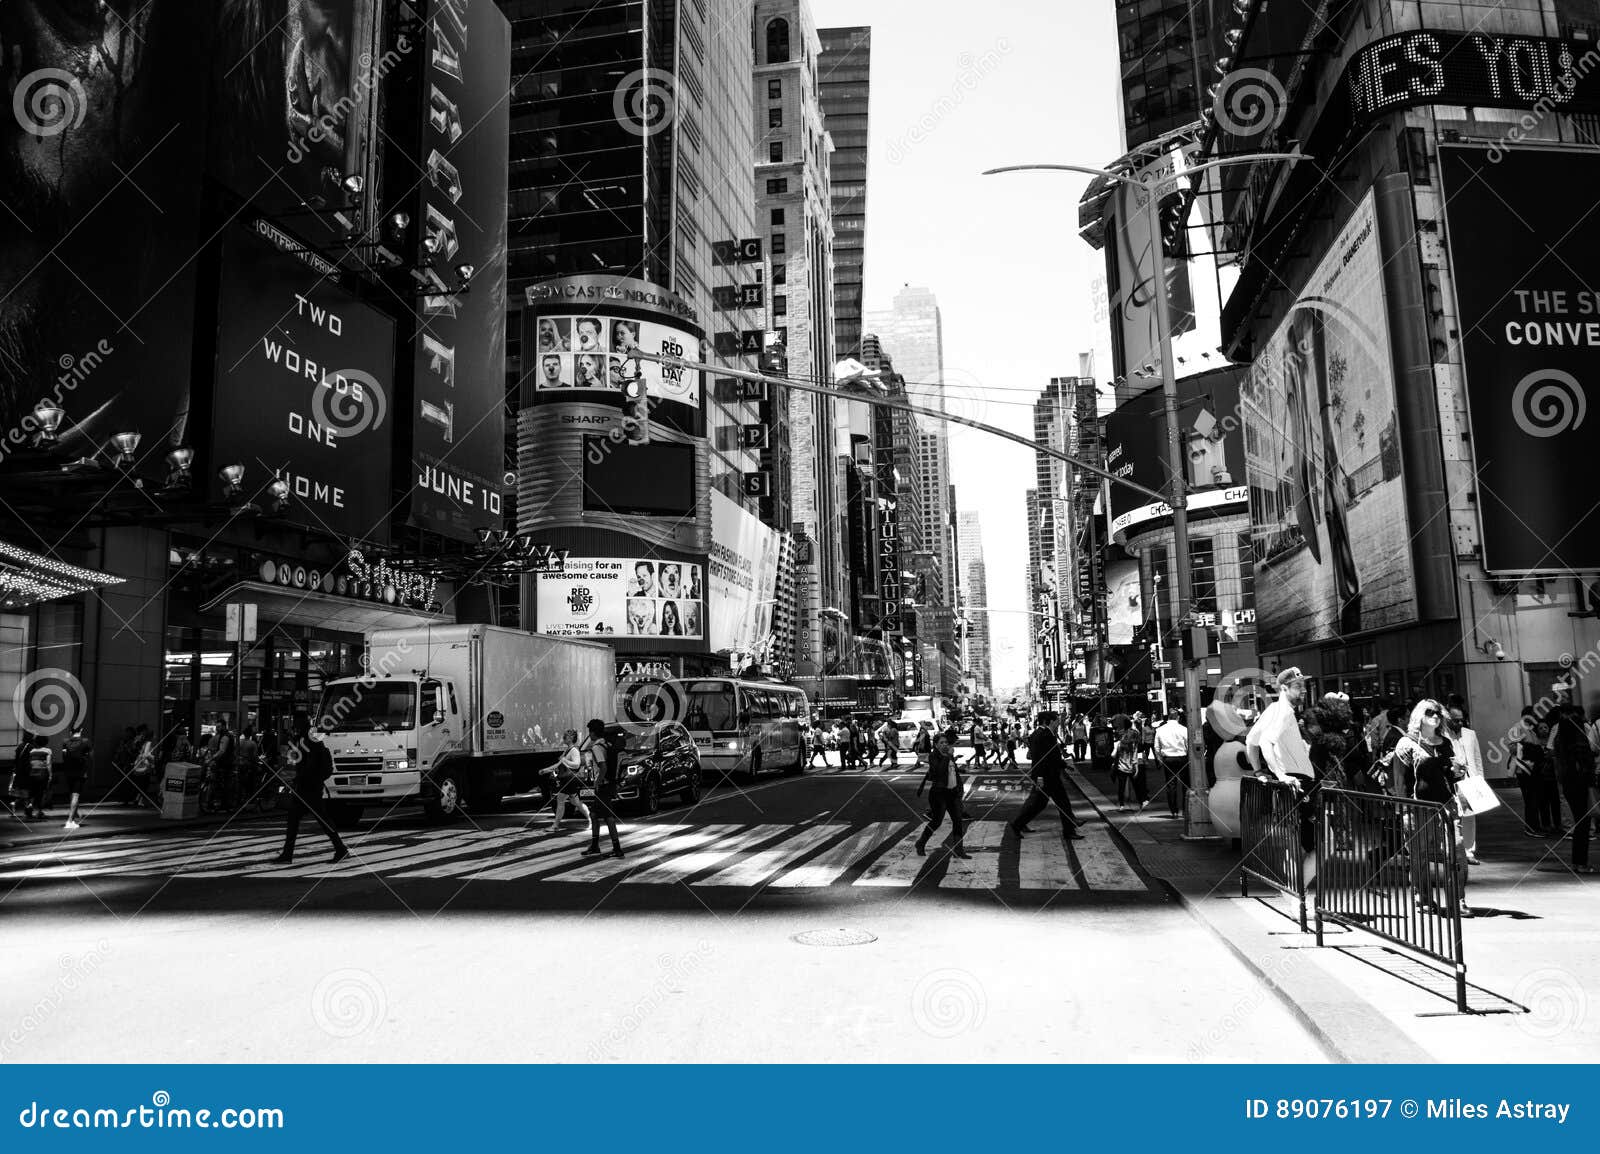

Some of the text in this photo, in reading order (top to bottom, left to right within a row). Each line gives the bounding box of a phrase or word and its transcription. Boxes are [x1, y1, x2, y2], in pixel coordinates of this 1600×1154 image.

[1473, 37, 1576, 103] YOU
[1513, 289, 1569, 314] THE
[295, 293, 342, 336] TWO
[1505, 320, 1600, 346] CONVE
[661, 340, 683, 357] RED
[264, 337, 363, 402] WORLDS
[661, 366, 684, 382] DAY
[561, 414, 610, 424] SHARP
[289, 412, 338, 448] ONE
[419, 465, 474, 505] JUNE
[482, 489, 500, 515] 10
[595, 560, 609, 570] for
[610, 562, 622, 570] an
[881, 509, 898, 631] TUSSAUDS
[348, 550, 438, 612] Subway
[567, 596, 593, 604] NSE
[571, 588, 590, 596] RED
[571, 604, 590, 612] DAY
[595, 621, 604, 633] 4
[614, 662, 672, 680] AMPS
